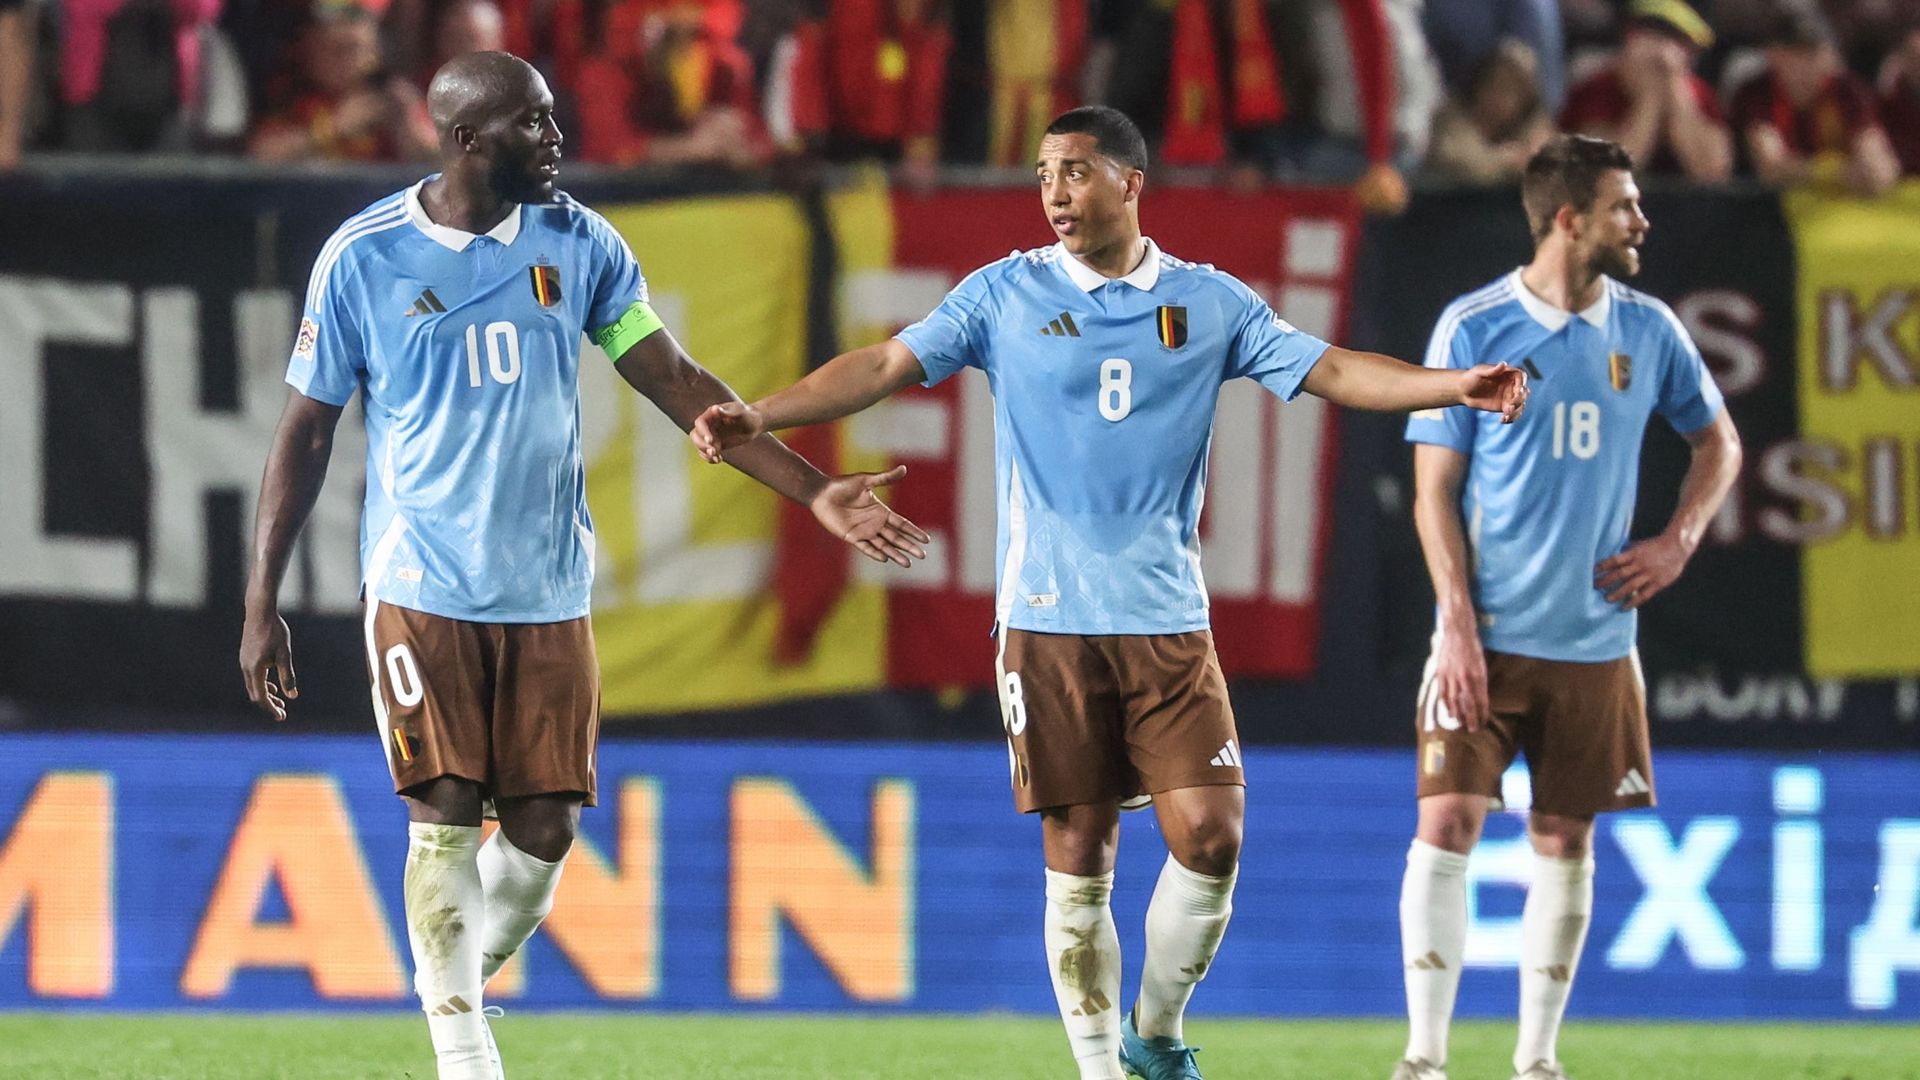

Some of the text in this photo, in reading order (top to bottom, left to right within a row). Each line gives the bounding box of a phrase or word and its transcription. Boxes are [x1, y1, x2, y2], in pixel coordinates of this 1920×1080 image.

[465, 320, 521, 388] 10
[1098, 358, 1132, 422] 8
[1552, 401, 1600, 459] 18
[1005, 671, 1027, 736] 8
